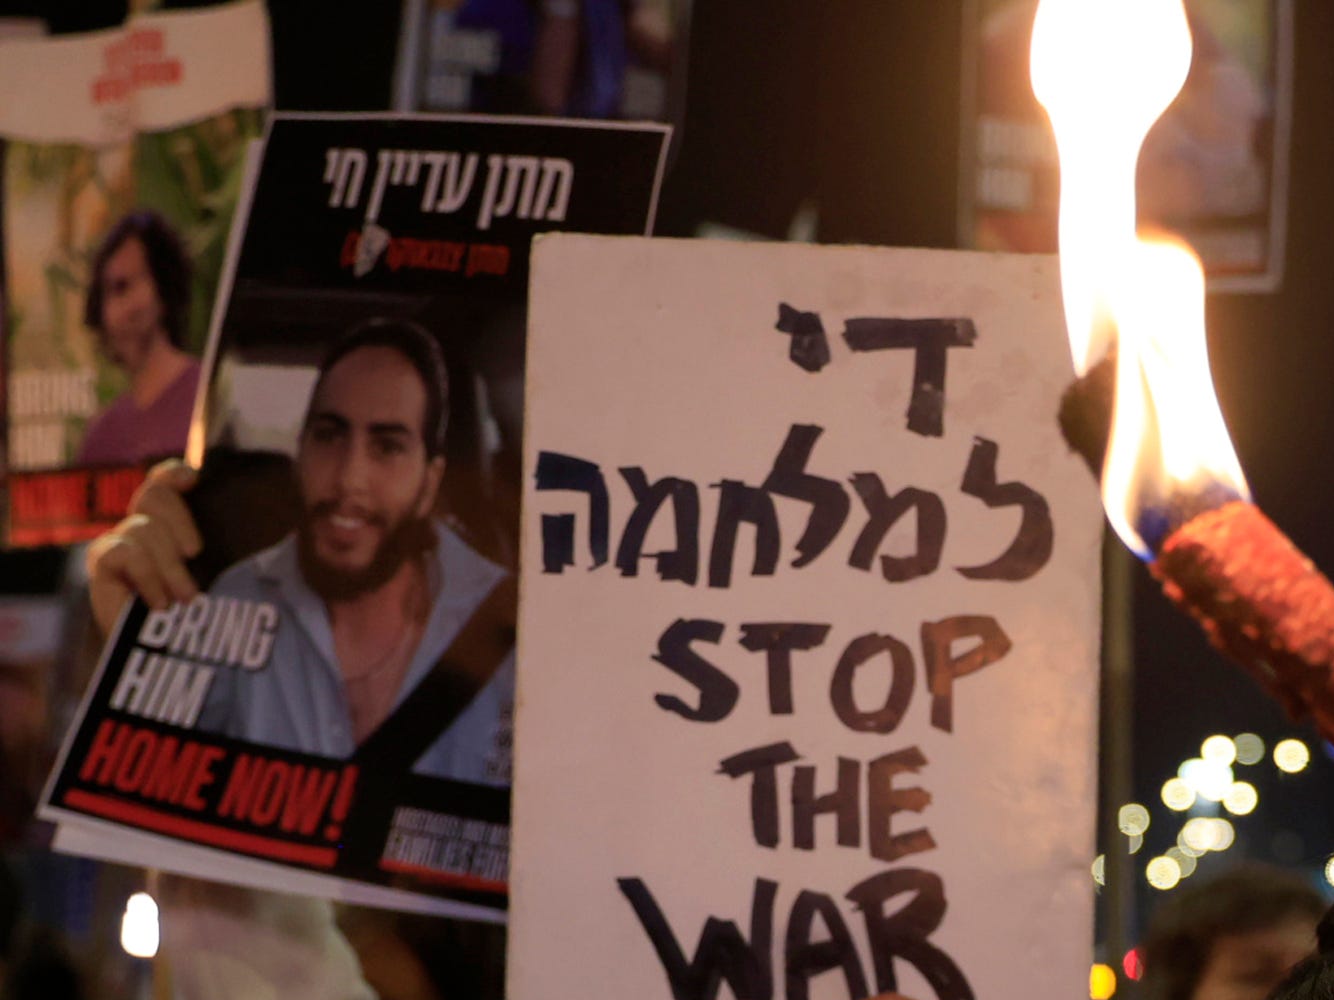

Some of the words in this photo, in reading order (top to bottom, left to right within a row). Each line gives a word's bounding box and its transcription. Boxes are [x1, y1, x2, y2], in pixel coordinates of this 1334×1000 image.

[322, 147, 369, 209] חי
[363, 149, 480, 224] עדיין
[475, 154, 575, 231] מתן
[776, 302, 977, 437] די
[535, 424, 1055, 588] למלחמה
[138, 594, 280, 671] BRING
[651, 616, 1013, 736] STOP
[108, 648, 215, 730] HIM
[79, 719, 227, 811] HOME
[217, 752, 360, 842] NOW!
[715, 741, 937, 862] THE
